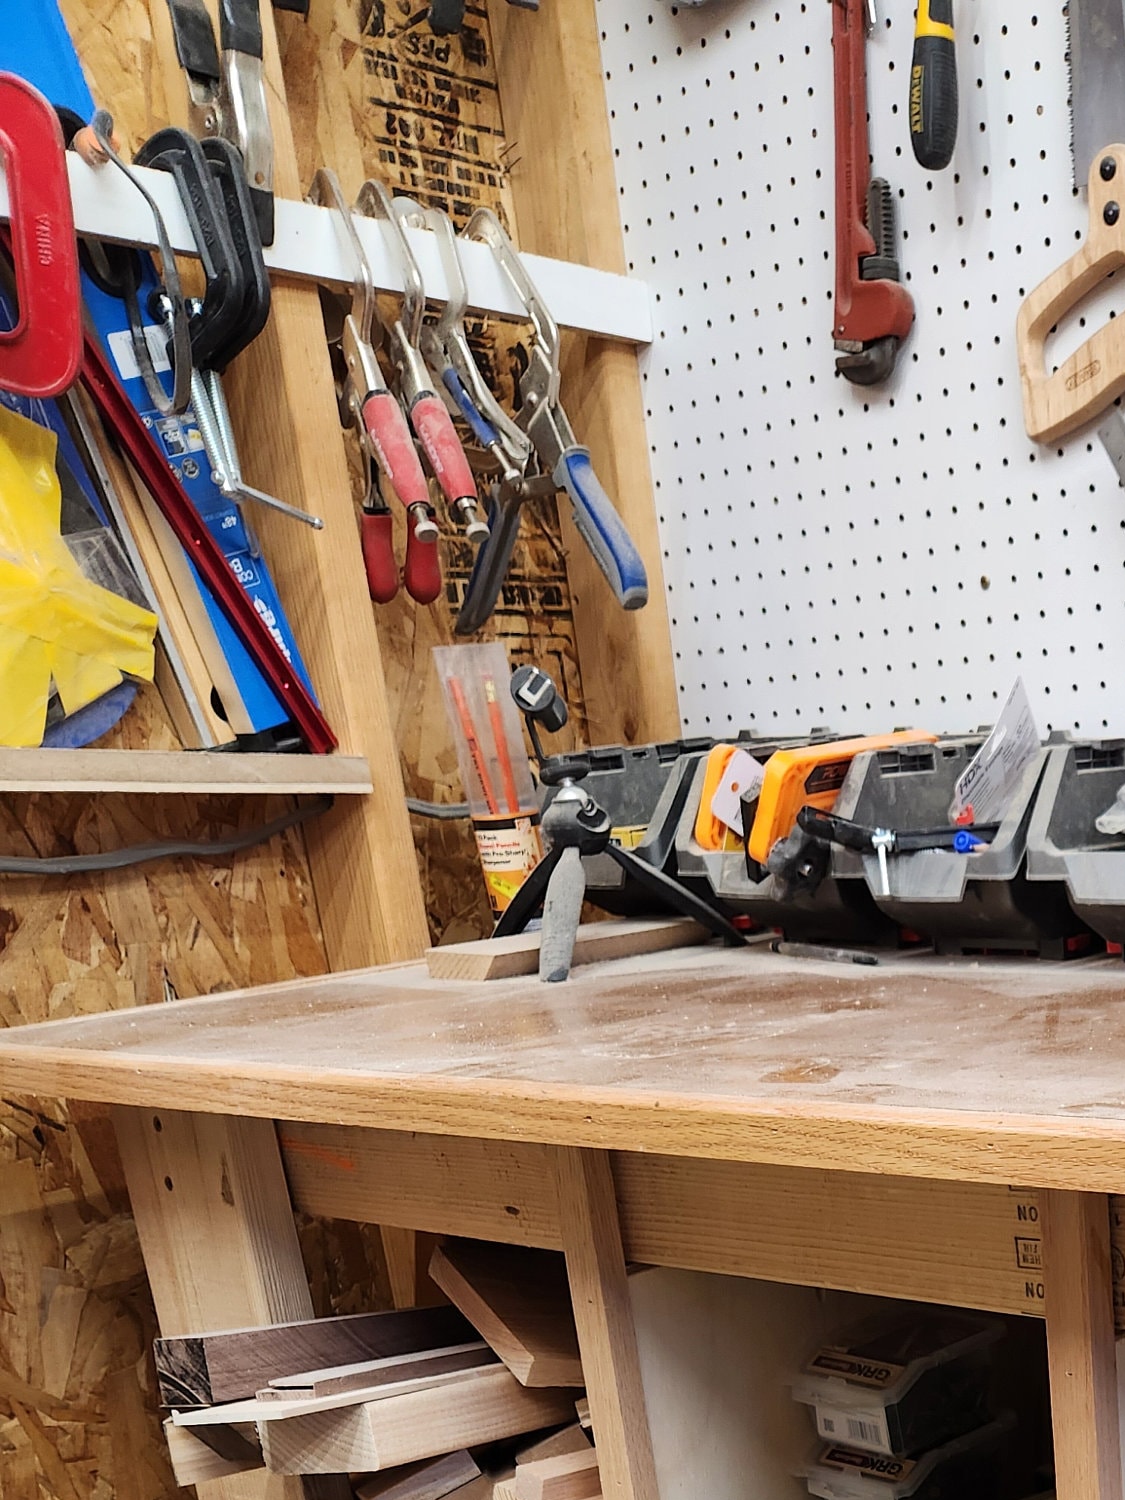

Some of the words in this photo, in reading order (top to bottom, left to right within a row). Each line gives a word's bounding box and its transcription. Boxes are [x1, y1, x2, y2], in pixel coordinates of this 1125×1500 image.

[911, 65, 924, 133] DEWALT
[853, 1362, 891, 1382] GRK
[868, 1457, 904, 1476] GRK
